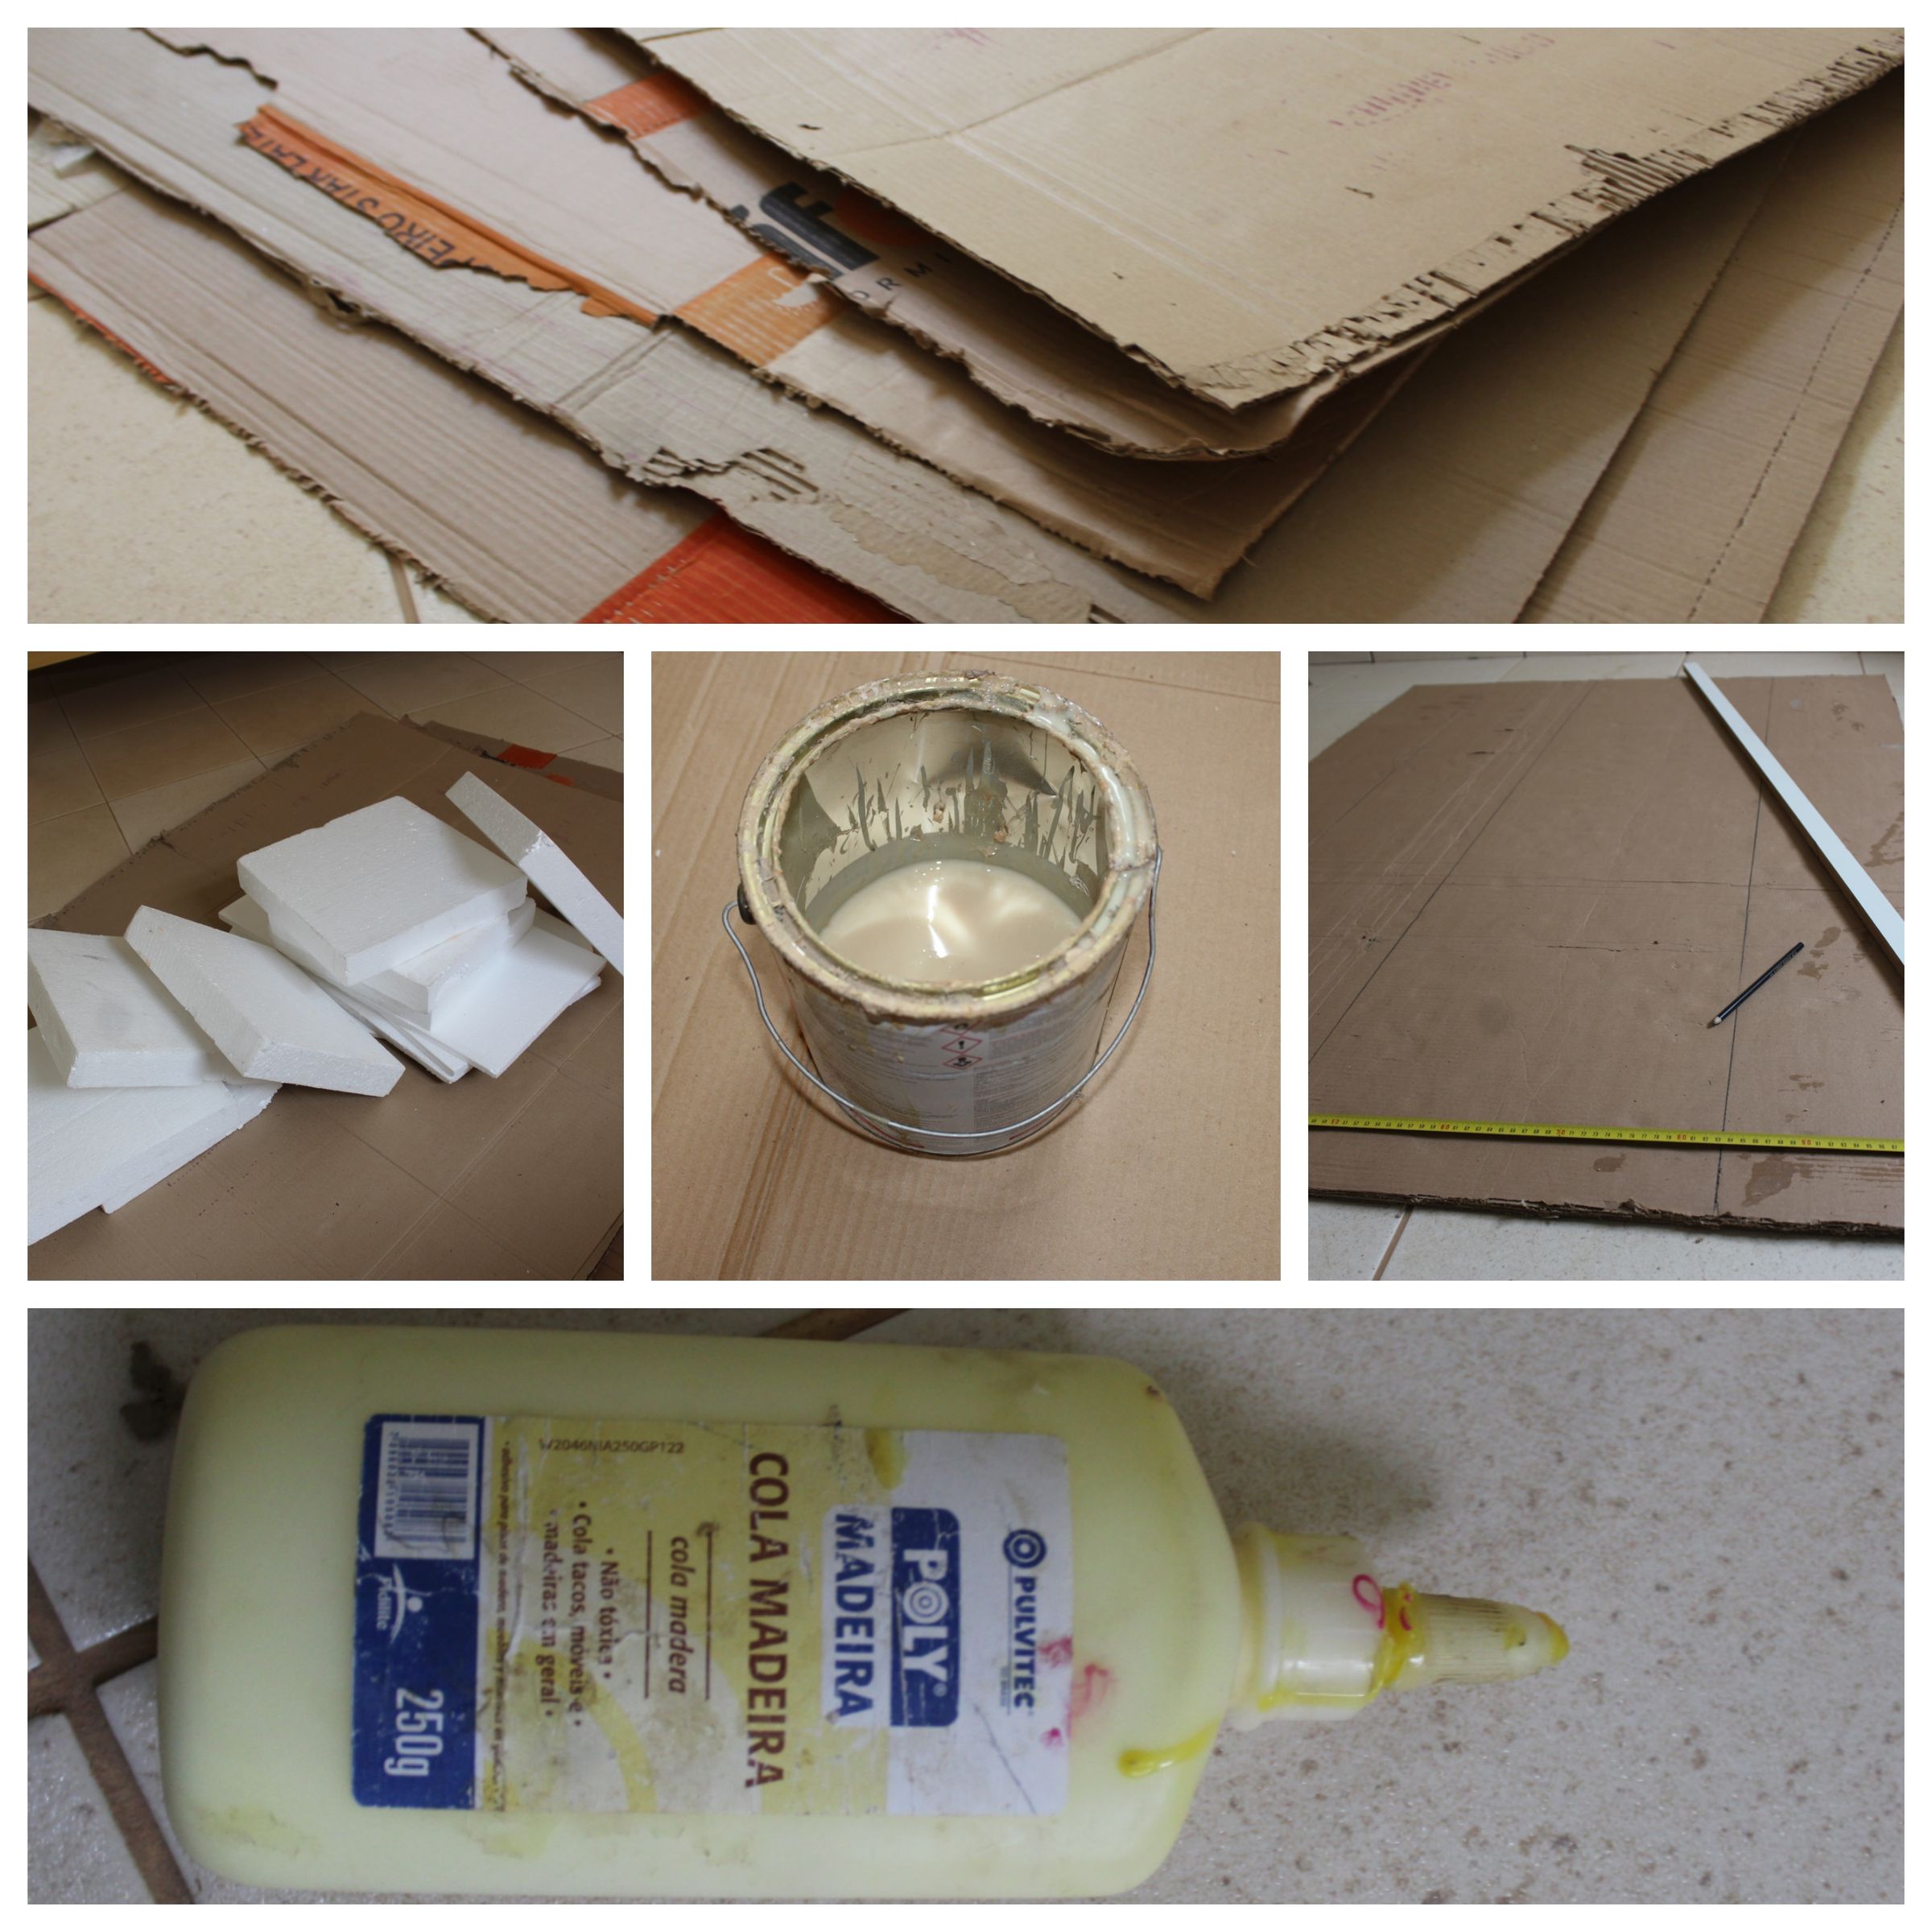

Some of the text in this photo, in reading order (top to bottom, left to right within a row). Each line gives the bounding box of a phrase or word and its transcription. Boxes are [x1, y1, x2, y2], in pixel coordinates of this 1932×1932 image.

[572, 1513, 592, 1555] Cola
[568, 1561, 589, 1617] tacos,
[600, 1561, 619, 1600] Não
[668, 1536, 696, 1694] cola madera
[745, 1452, 789, 1788] COLA MADEIRA
[835, 1514, 874, 1716] MADEIRA
[535, 1654, 561, 1704] geral
[1013, 1576, 1037, 1709] PULVITEC
[384, 1689, 444, 1777] 250g
